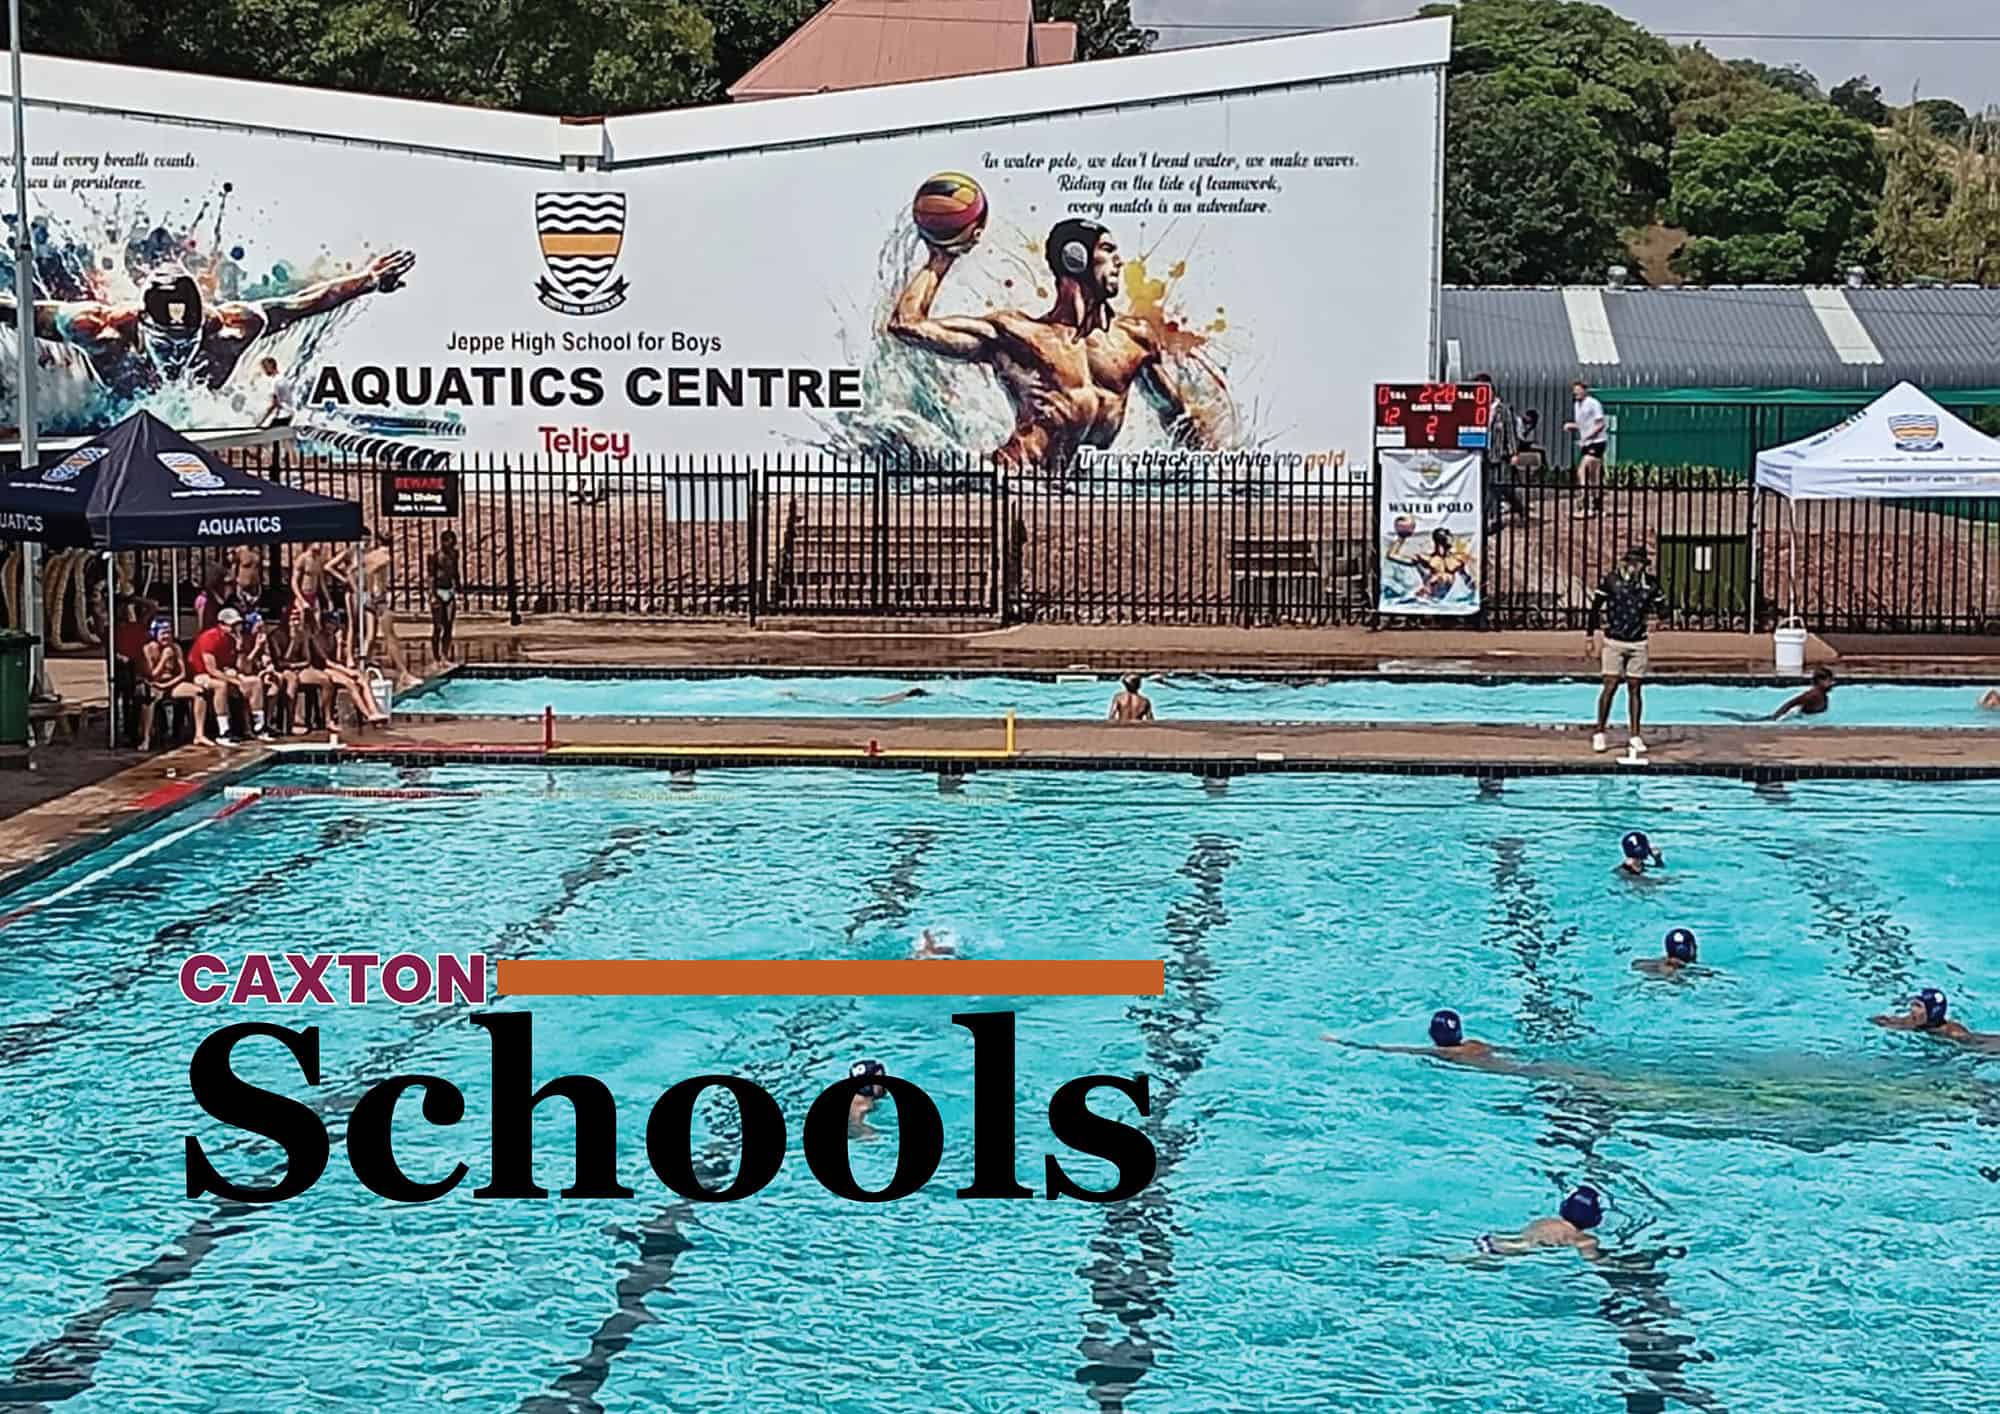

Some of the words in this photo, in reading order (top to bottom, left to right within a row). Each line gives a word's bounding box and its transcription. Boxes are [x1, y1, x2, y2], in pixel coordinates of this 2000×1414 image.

[31, 151, 60, 167] and
[63, 156, 99, 173] every
[104, 152, 149, 167] breath
[983, 152, 999, 169] In
[1004, 152, 1045, 168] water
[1048, 152, 1082, 173] polo,
[1087, 156, 1107, 168] we
[1111, 152, 1147, 168] don't
[1194, 152, 1240, 171] water,
[1245, 155, 1265, 168] we
[1270, 152, 1309, 168] make
[53, 174, 67, 189] in
[1057, 174, 1106, 196] Riding
[1111, 180, 1127, 190] on
[1132, 175, 1153, 190] the
[1158, 175, 1184, 190] tide
[1189, 175, 1203, 197] of
[1206, 175, 1283, 193] teamwork,
[1067, 201, 1104, 219] every
[1109, 199, 1152, 213] match
[1158, 199, 1168, 213] is
[1173, 202, 1192, 213] an
[446, 332, 505, 353] Jeppe
[511, 332, 556, 354] High
[562, 332, 632, 351] School
[637, 332, 665, 351] for
[671, 332, 722, 353] Boys
[311, 366, 604, 408] AQUATICS
[625, 368, 863, 409] CENTRE
[1476, 386, 1487, 404] 0
[1426, 415, 1438, 434] 2
[1476, 407, 1487, 425] 0
[539, 426, 631, 460] Teljoy
[1389, 502, 1433, 514] WATER
[1437, 502, 1474, 514] POLO
[197, 516, 282, 536] AQUATICS
